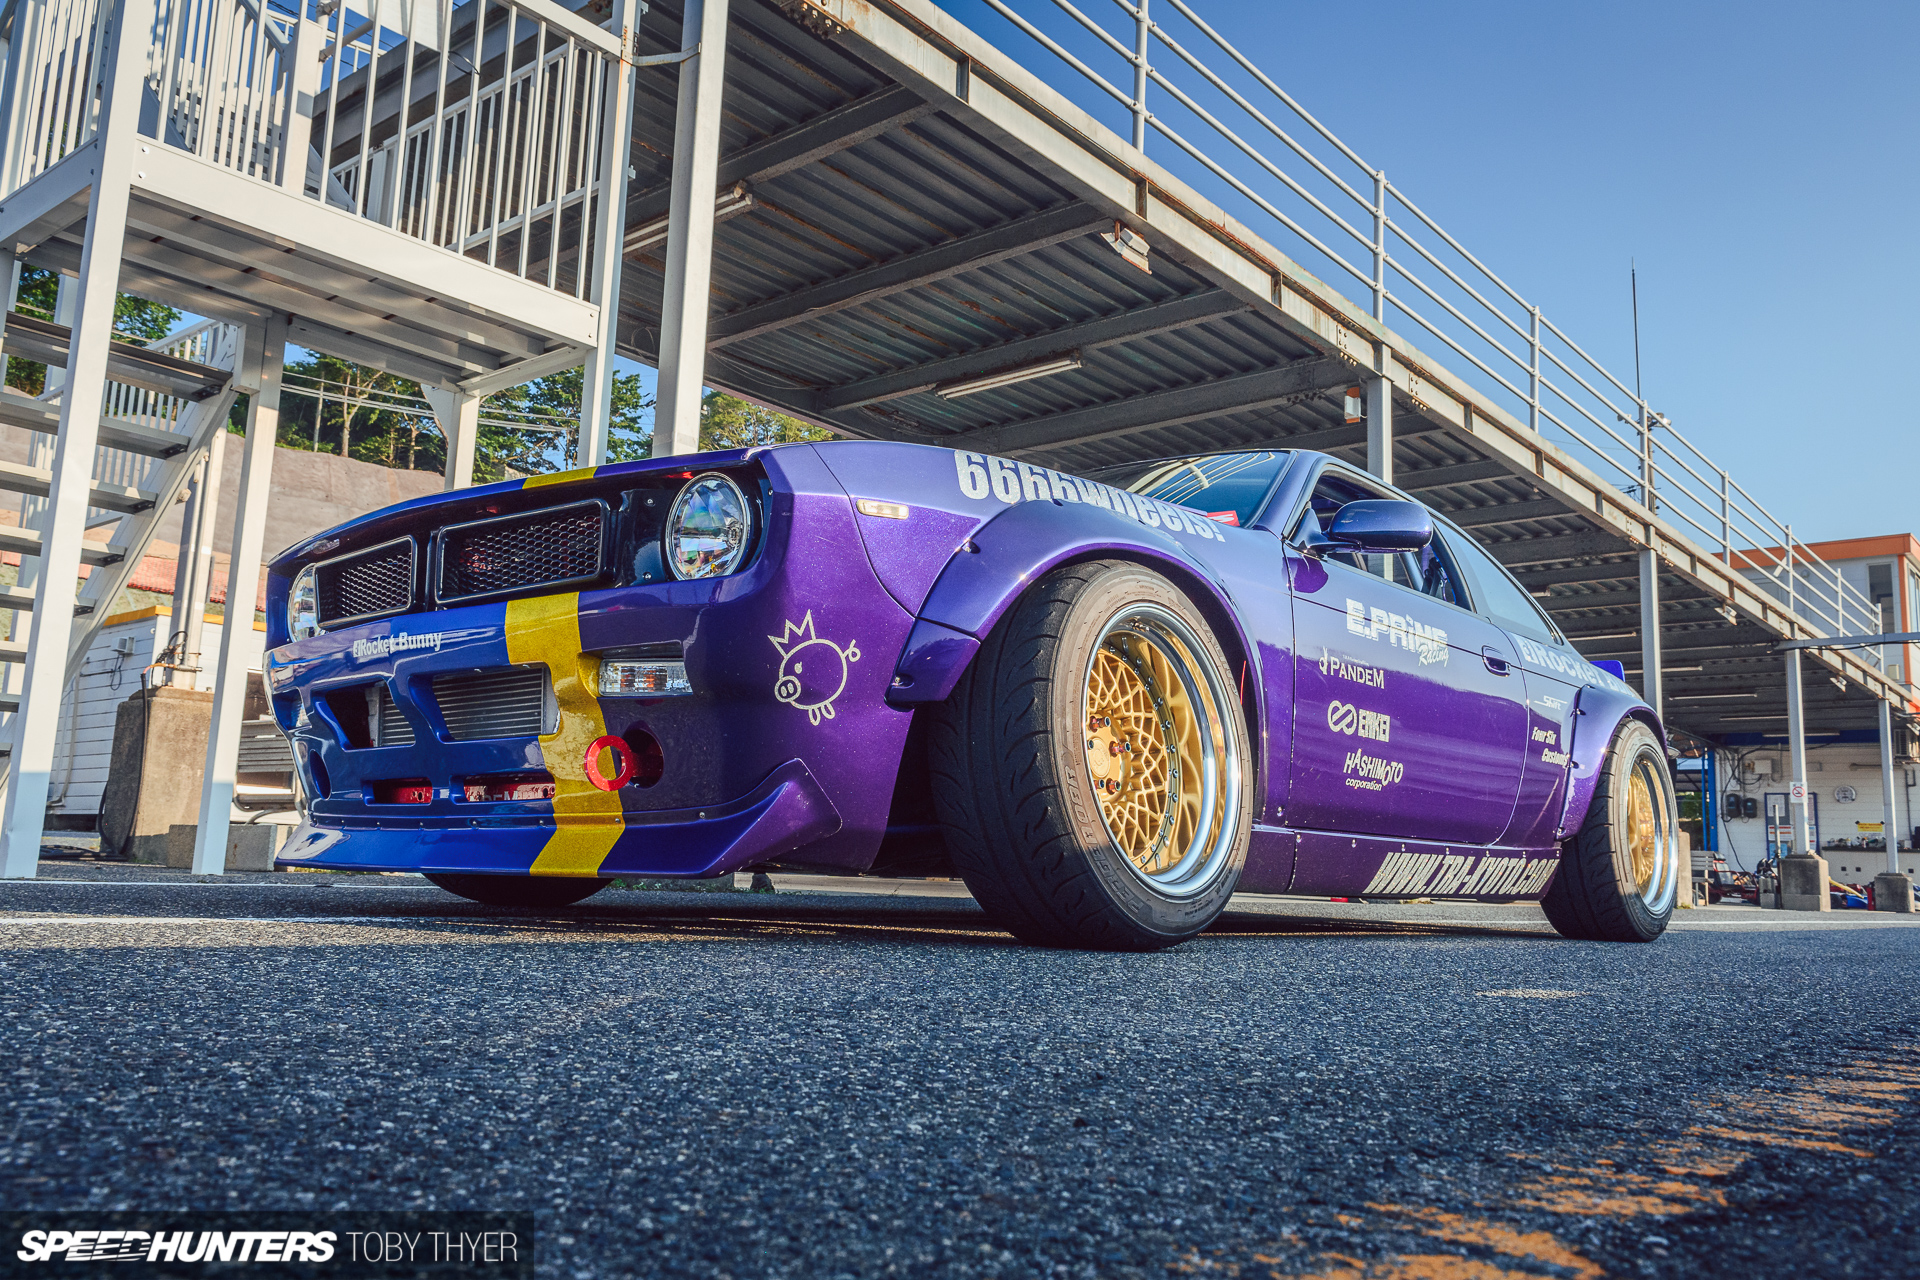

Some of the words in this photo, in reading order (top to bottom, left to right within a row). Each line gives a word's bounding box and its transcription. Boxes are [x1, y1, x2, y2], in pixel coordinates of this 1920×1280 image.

[360, 634, 394, 657] Rocket
[399, 631, 442, 651] Bunny
[1417, 644, 1449, 668] Racing
[1330, 656, 1385, 689] PANDEM
[1358, 708, 1391, 742] ENKEI
[1531, 726, 1547, 742] Four
[1545, 730, 1557, 745] Six
[1343, 748, 1404, 786] HASHIMOTO
[1345, 778, 1382, 791] corporation
[1361, 851, 1560, 895] WWW.TRA-KYOTO.COM
